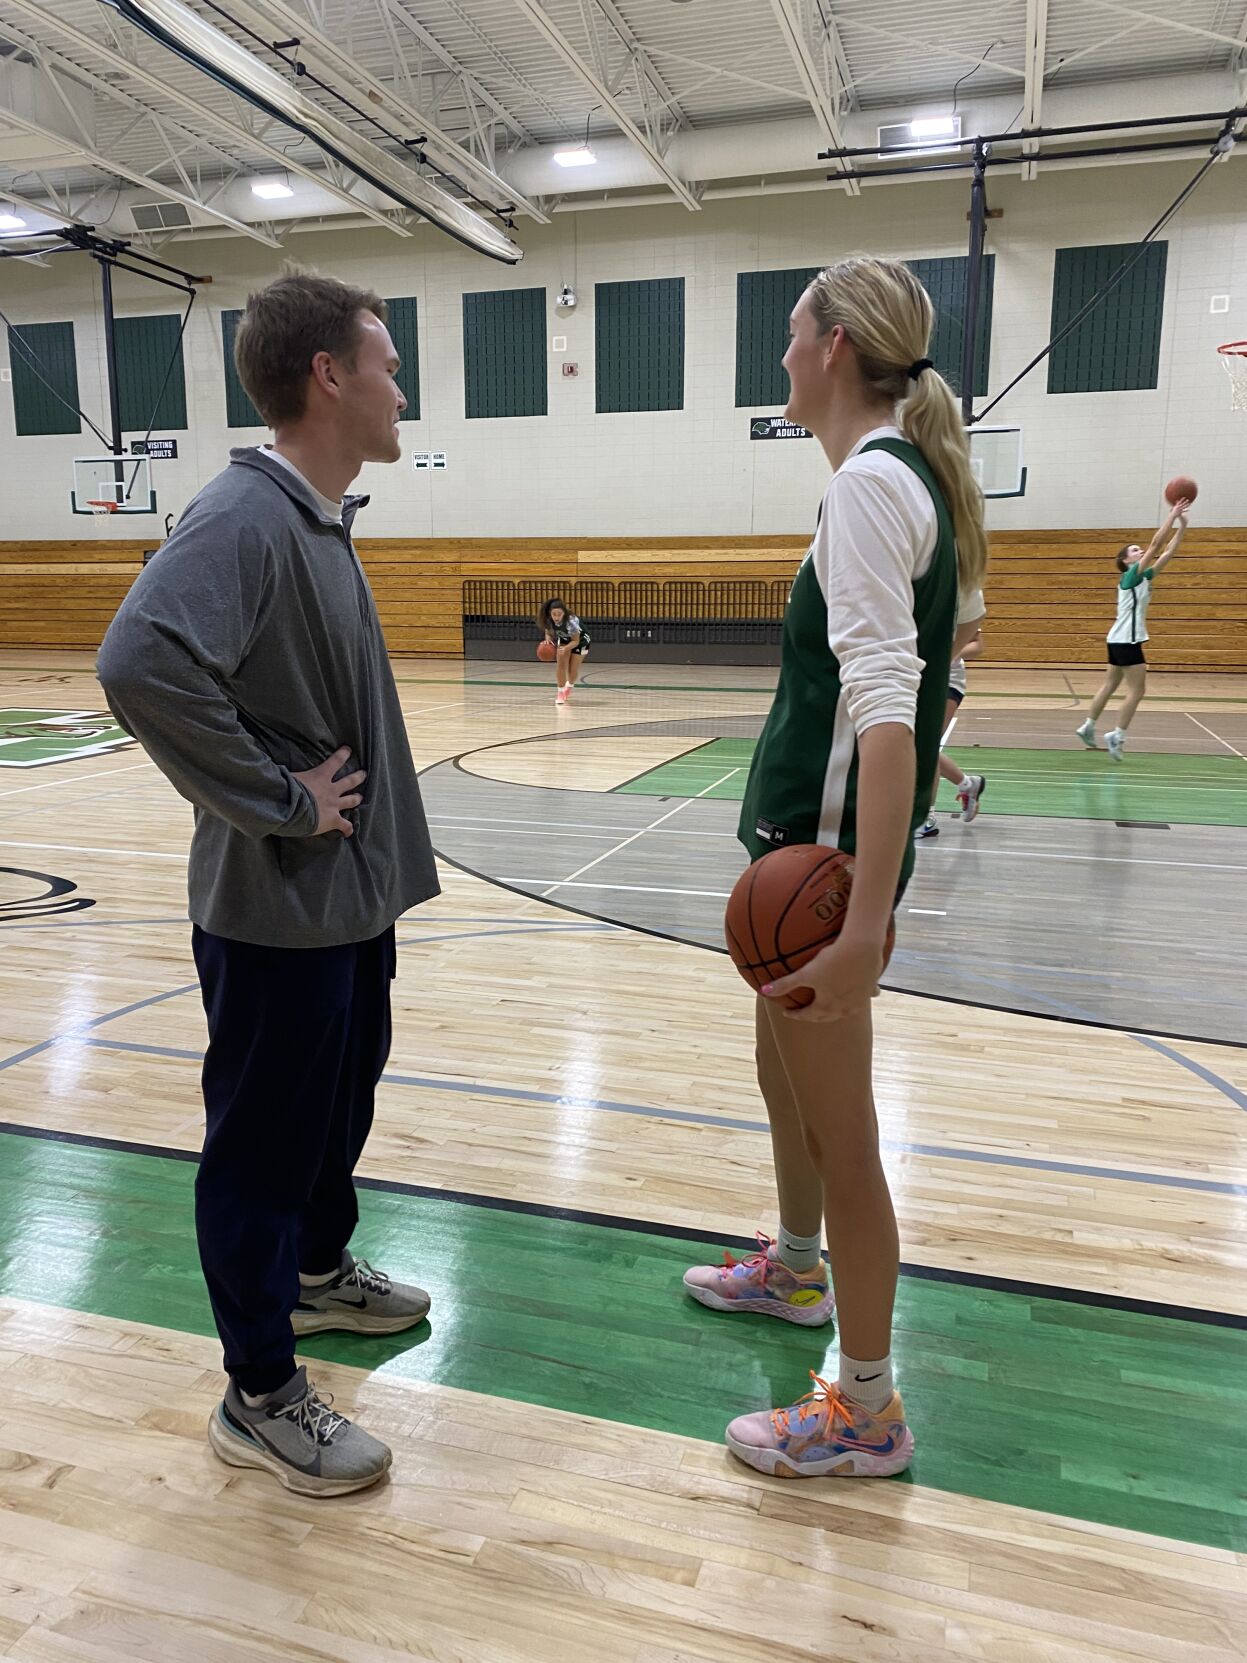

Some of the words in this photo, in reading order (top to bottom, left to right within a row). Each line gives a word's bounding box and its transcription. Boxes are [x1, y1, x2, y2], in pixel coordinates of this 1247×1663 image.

[776, 428, 806, 437] ADULTS
[147, 441, 173, 449] VISITING
[774, 831, 784, 841] M
